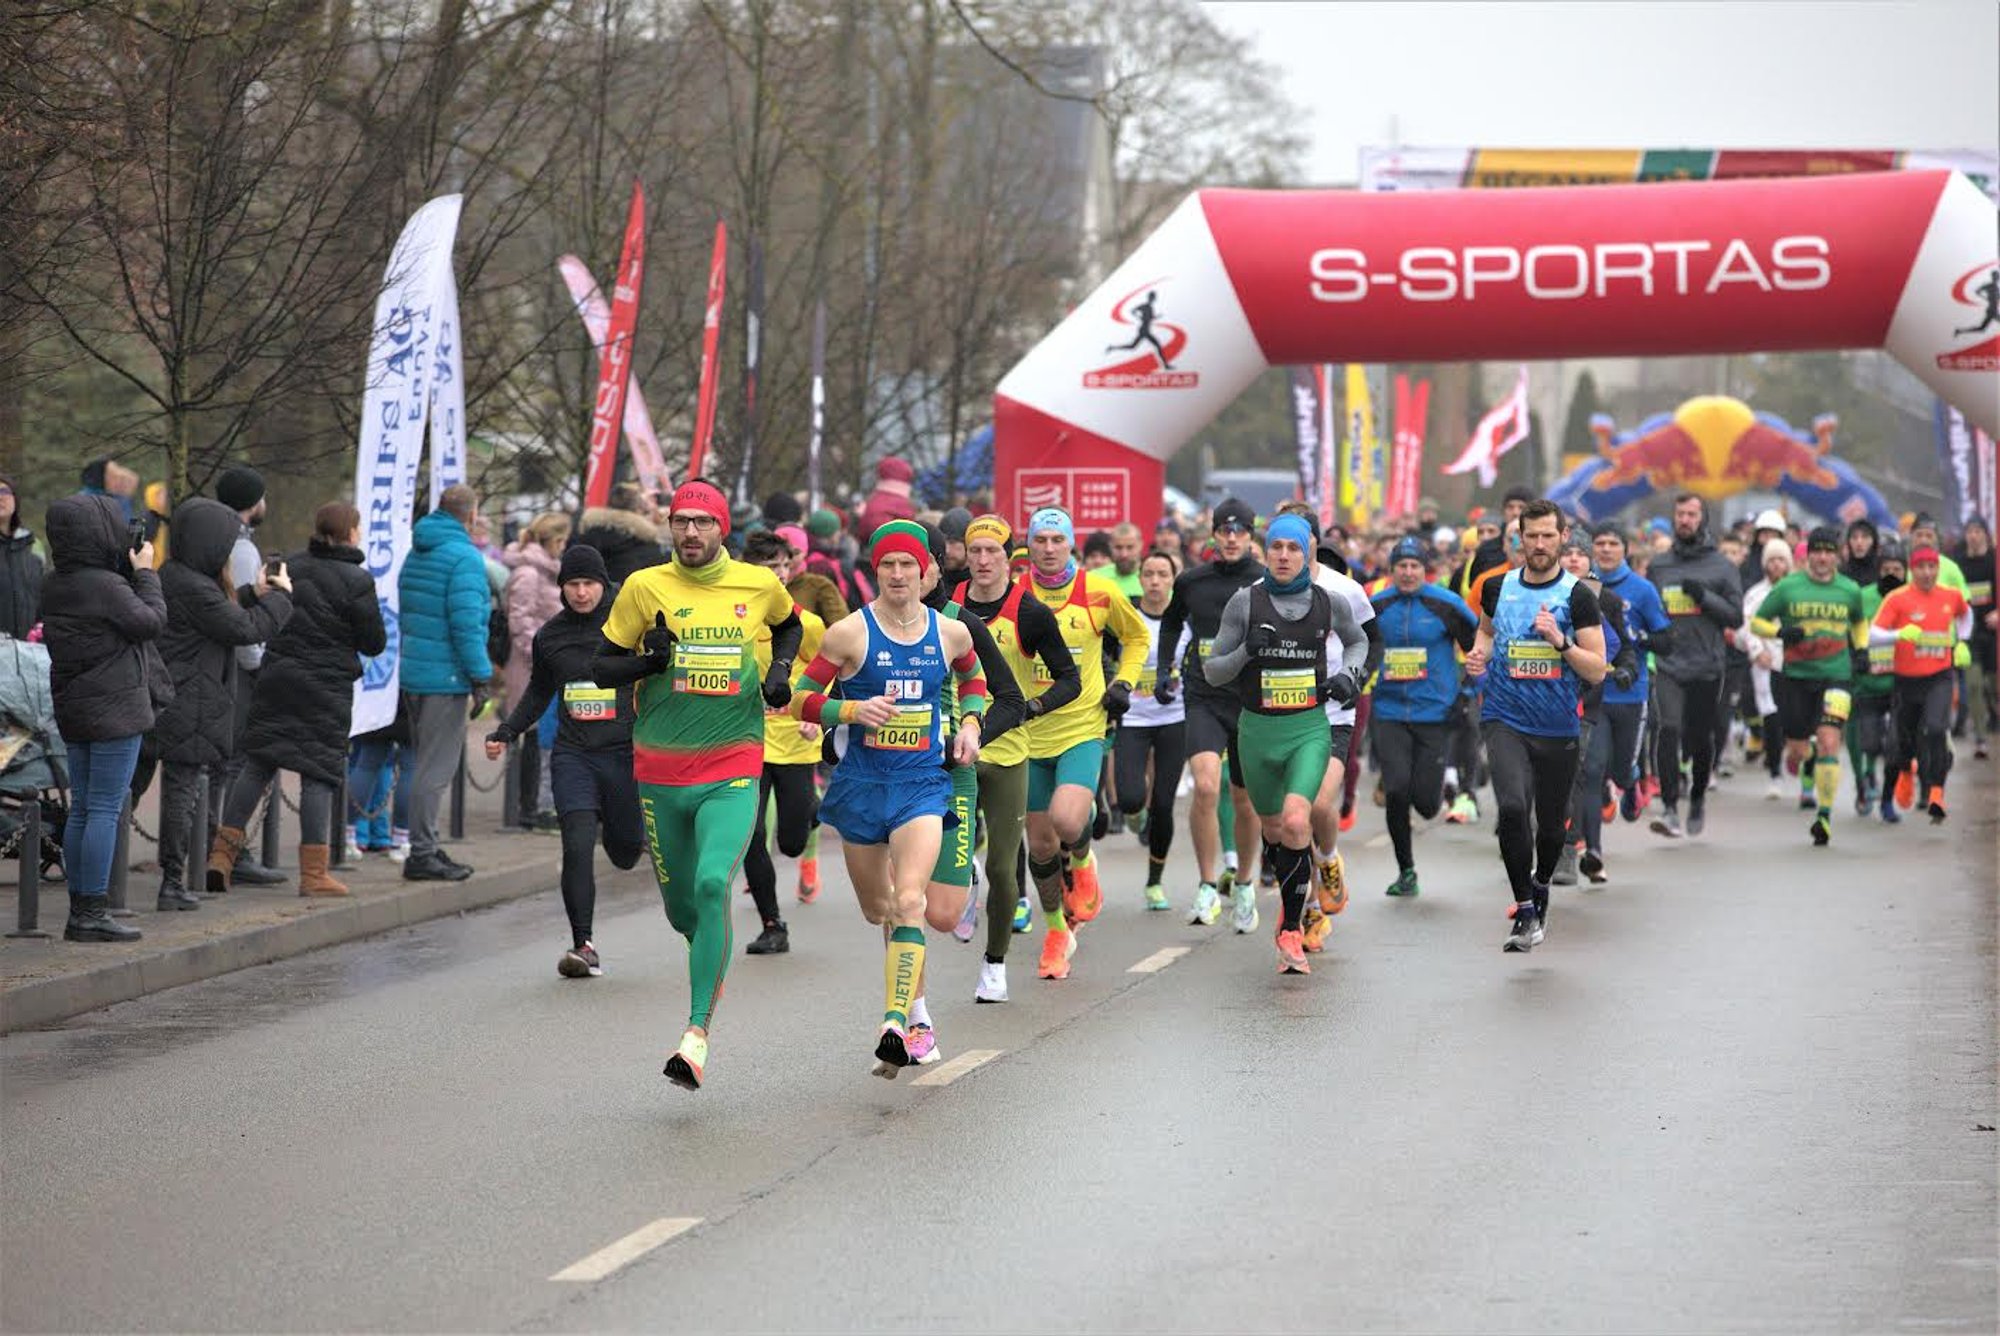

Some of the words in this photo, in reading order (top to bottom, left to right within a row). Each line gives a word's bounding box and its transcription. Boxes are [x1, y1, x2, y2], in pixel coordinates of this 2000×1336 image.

[1309, 236, 1832, 301] S-SPORTAS
[367, 401, 400, 578] GRIFS
[681, 627, 744, 640] LIETUVA
[1281, 640, 1298, 648] TOP
[1519, 661, 1548, 675] 480
[688, 673, 728, 690] 1006
[1273, 692, 1307, 704] 1010
[575, 703, 602, 716] 399
[878, 730, 918, 745] 1040
[955, 796, 969, 868] LIETUVA
[895, 951, 915, 1008] LIETUVA
